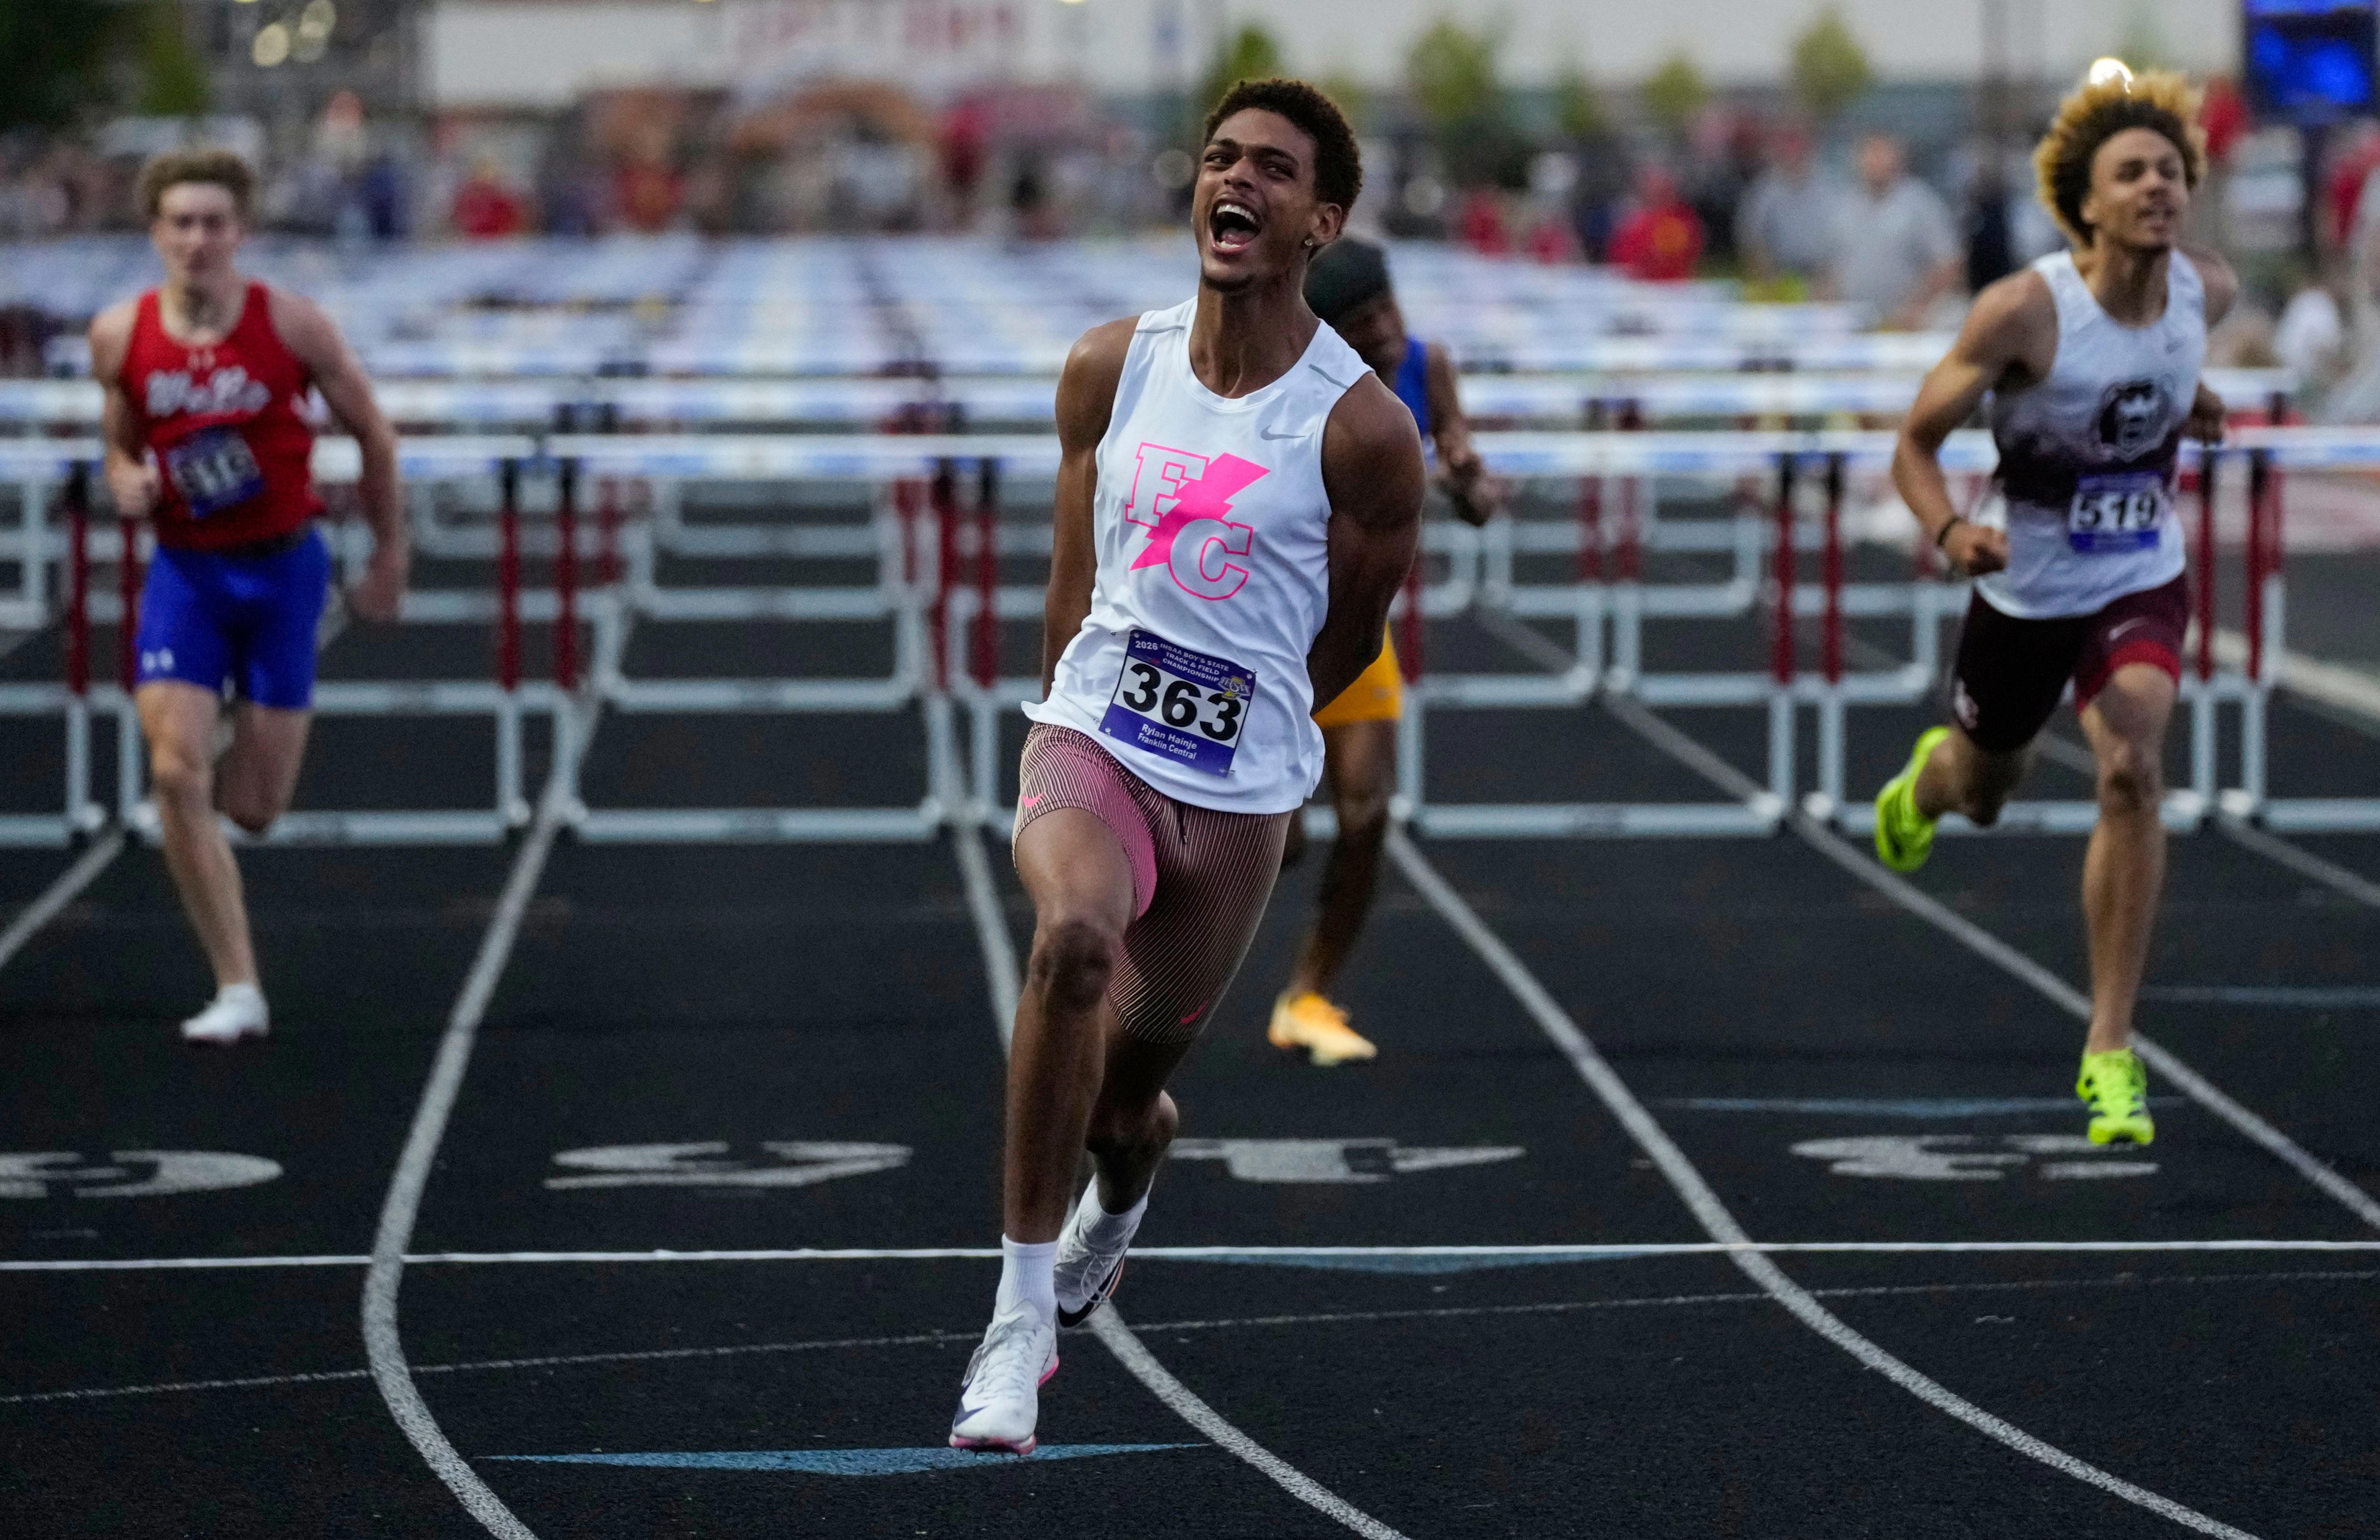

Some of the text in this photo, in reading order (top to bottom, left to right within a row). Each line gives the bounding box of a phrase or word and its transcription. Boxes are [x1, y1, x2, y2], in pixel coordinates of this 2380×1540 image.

[2077, 491, 2158, 527] 519
[1135, 640, 1230, 672] 2026 IHSAA BOY'S STATE
[1162, 658, 1220, 682] CHAMPIONSHIP
[1166, 652, 1188, 665] TRACK
[1198, 664, 1220, 676] FIELD
[1123, 663, 1241, 741] 363
[1138, 732, 1197, 760] Franklin Central
[1142, 723, 1197, 750] Rylan Hainje
